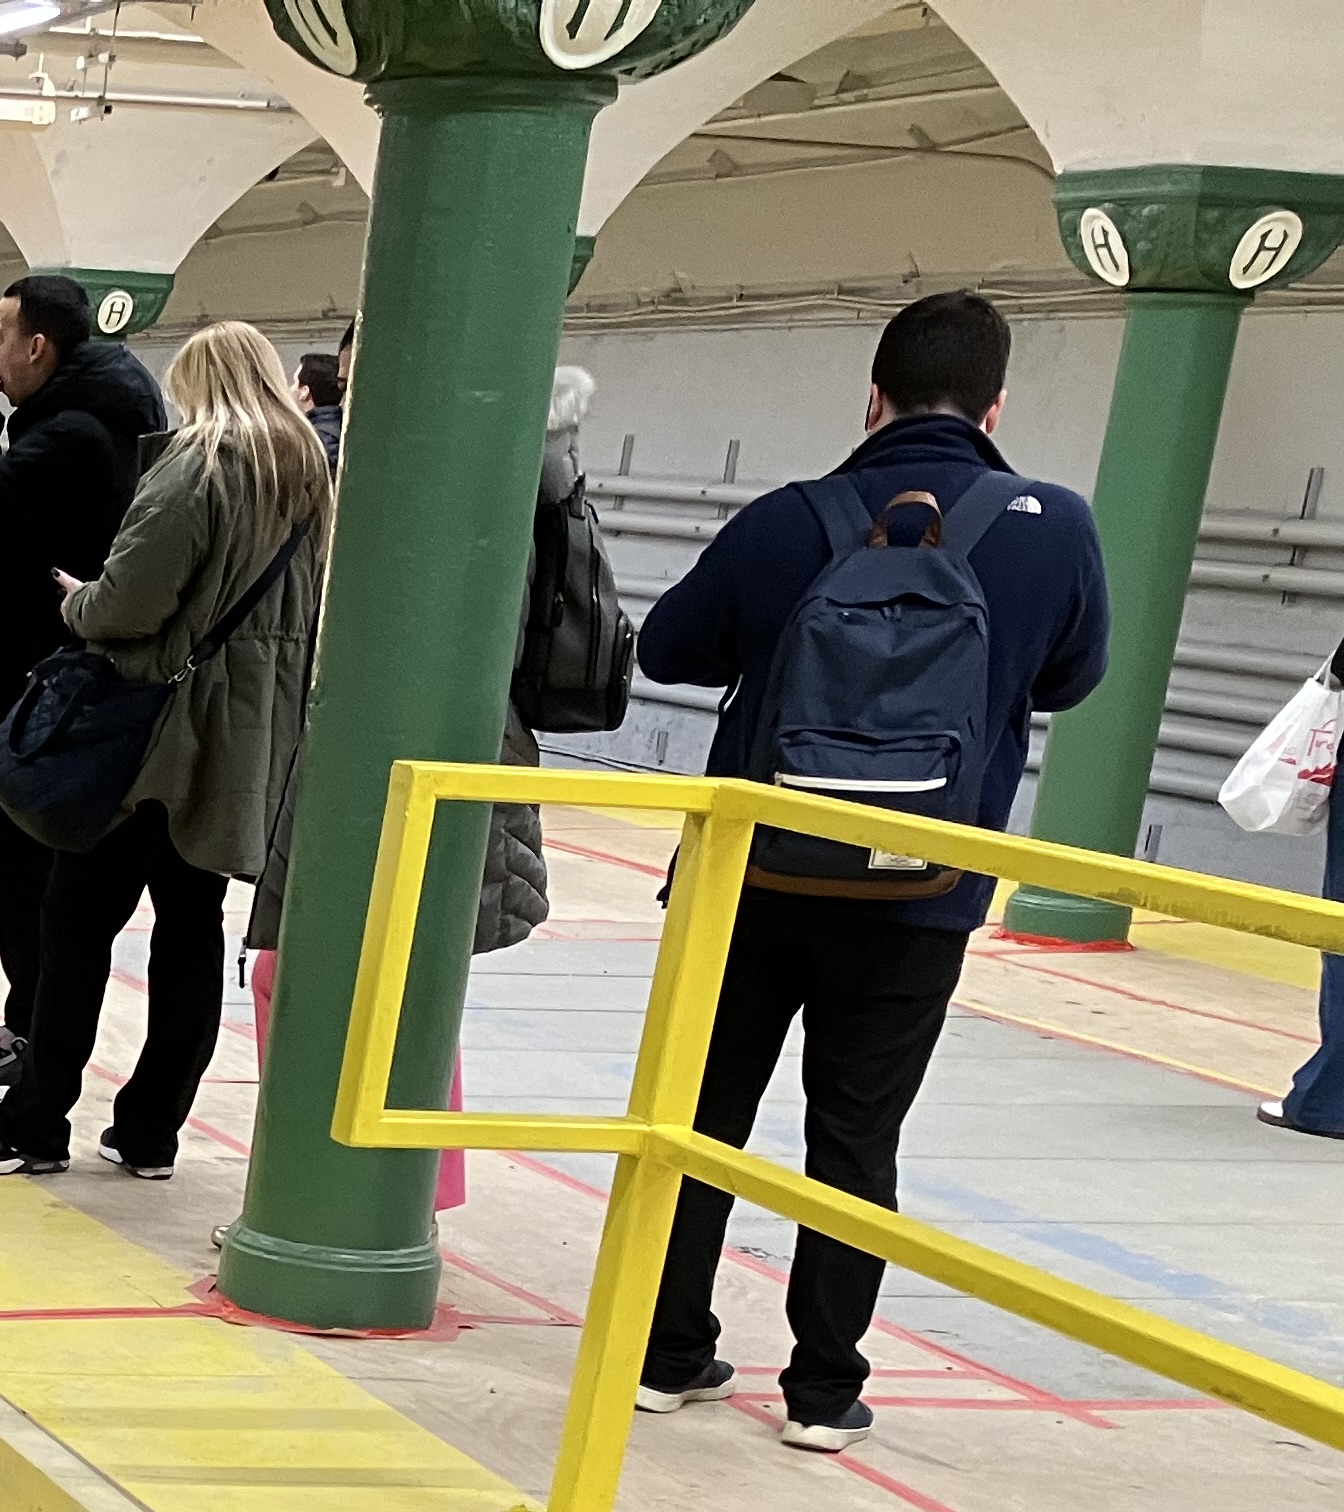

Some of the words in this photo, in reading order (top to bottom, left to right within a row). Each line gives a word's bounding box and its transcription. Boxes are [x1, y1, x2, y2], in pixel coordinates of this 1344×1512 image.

[1091, 225, 1120, 272] H
[1242, 228, 1289, 275] H
[105, 301, 126, 325] H
